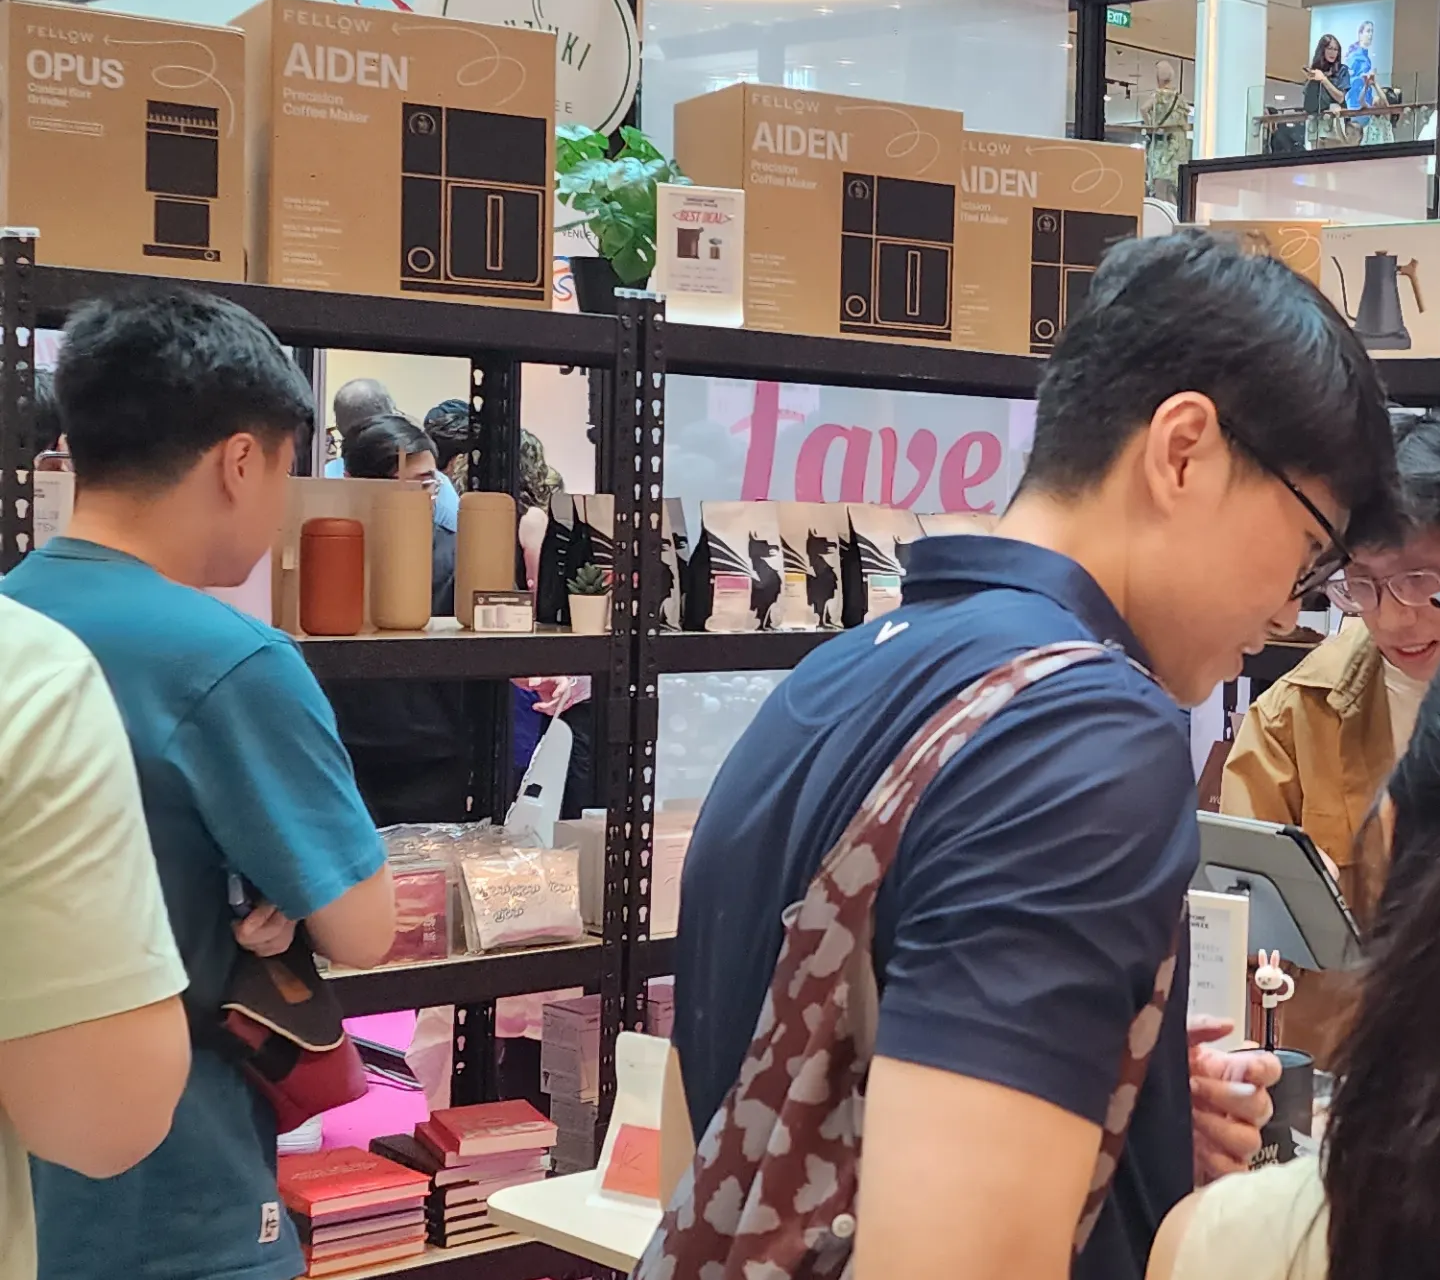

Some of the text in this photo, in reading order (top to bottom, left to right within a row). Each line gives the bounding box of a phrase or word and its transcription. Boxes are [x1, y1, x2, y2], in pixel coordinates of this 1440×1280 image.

[283, 8, 372, 36] FELLOW
[26, 24, 95, 44] FELLOW
[27, 49, 125, 89] OPUS
[283, 41, 409, 92] AIDEN
[283, 86, 344, 106] Precision
[751, 92, 820, 116] FELLOW
[282, 102, 370, 124] Coffee Maker
[751, 121, 849, 162] AIDEN
[750, 158, 798, 176] Precision
[750, 172, 818, 192] Coffee Maker
